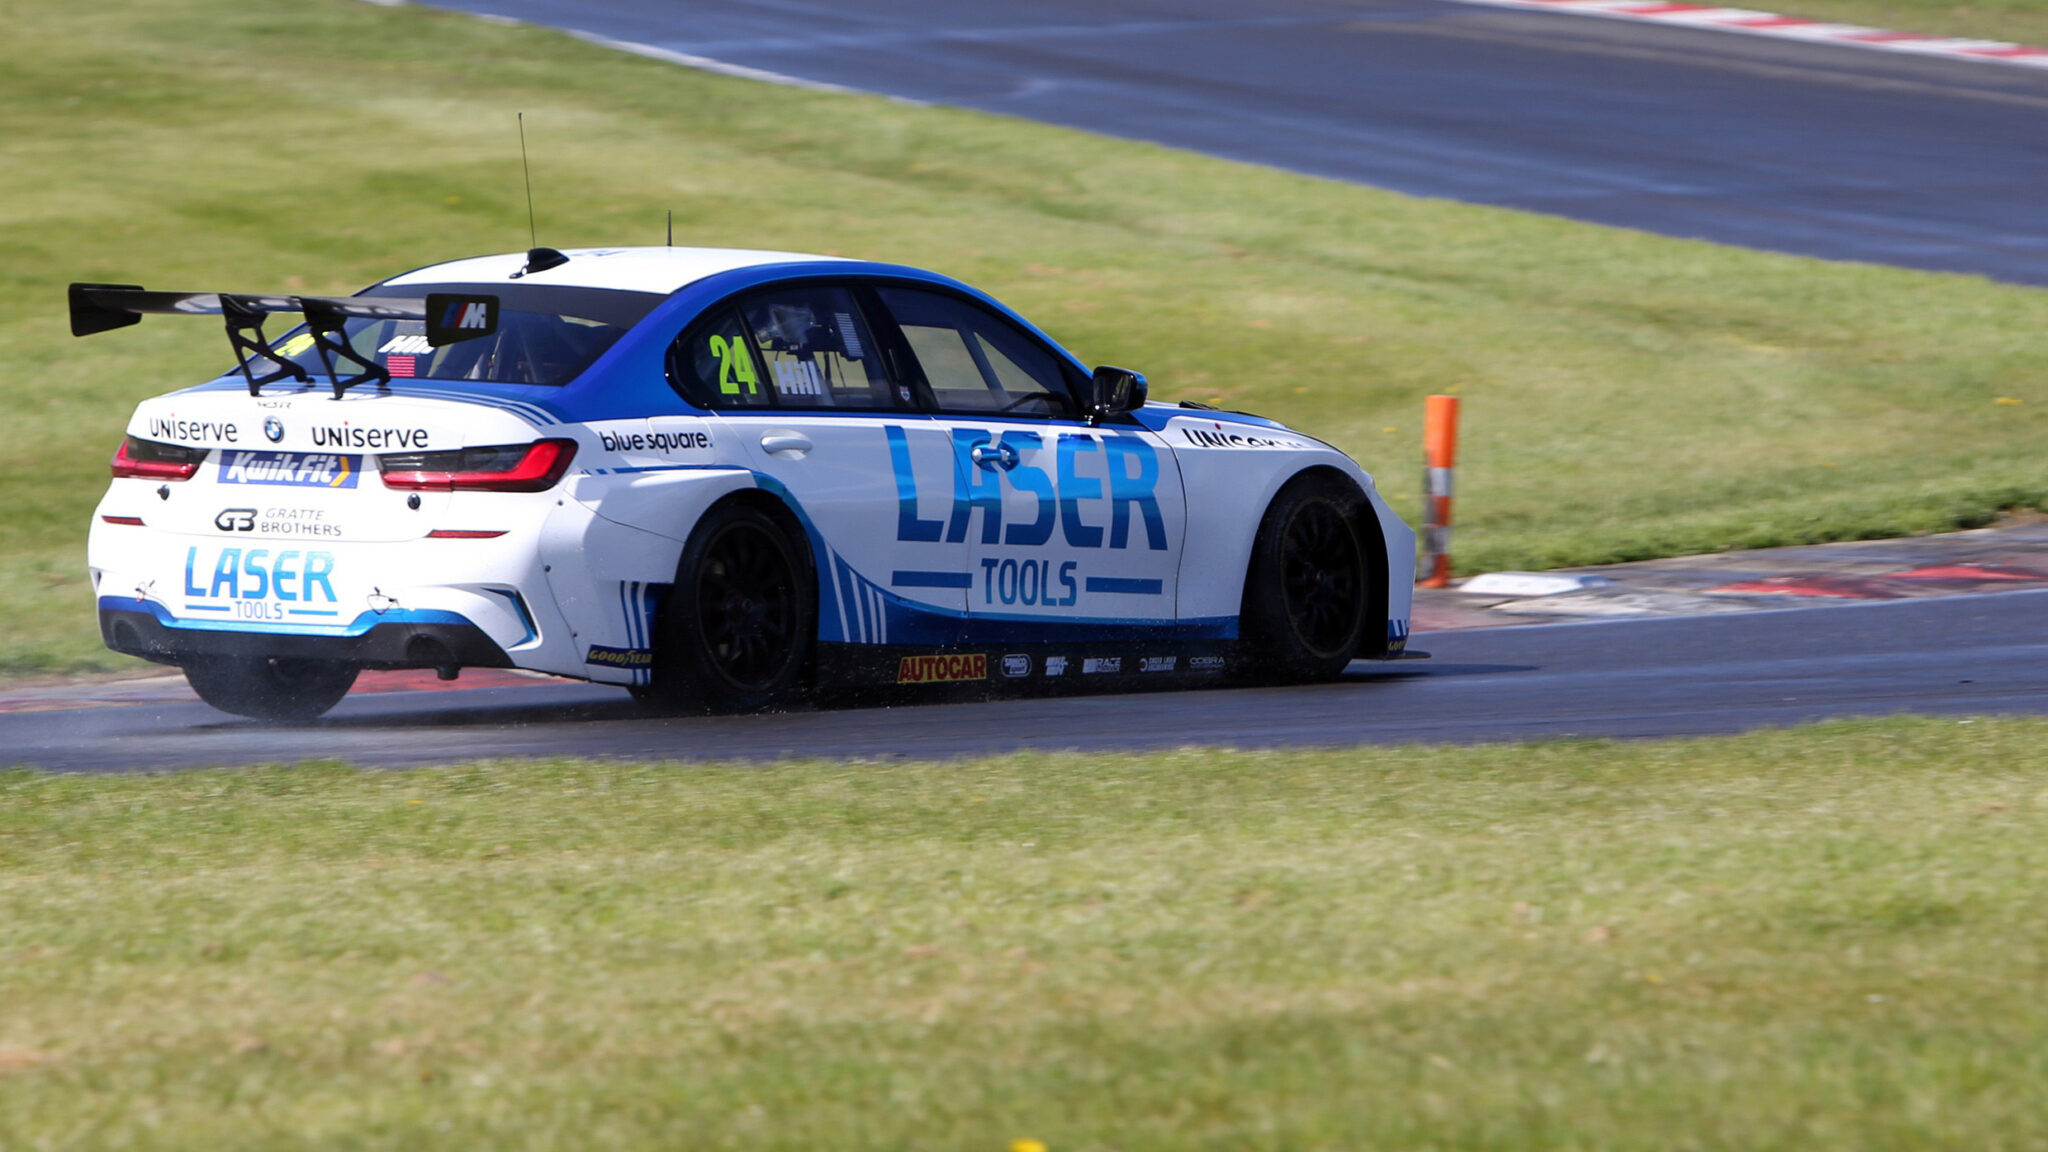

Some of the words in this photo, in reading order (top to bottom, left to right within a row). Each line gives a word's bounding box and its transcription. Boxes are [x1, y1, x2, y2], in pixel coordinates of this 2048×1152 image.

[709, 334, 758, 395] 24
[774, 360, 822, 395] Hill
[599, 431, 644, 452] blue
[883, 424, 1169, 551] LASER
[260, 521, 342, 536] BROTHERS
[265, 507, 324, 521] GRATTE
[184, 546, 338, 602] LASER
[980, 557, 1078, 607] TOOLS
[235, 600, 284, 620] TOOLS
[899, 655, 986, 681] AUTOCAR
